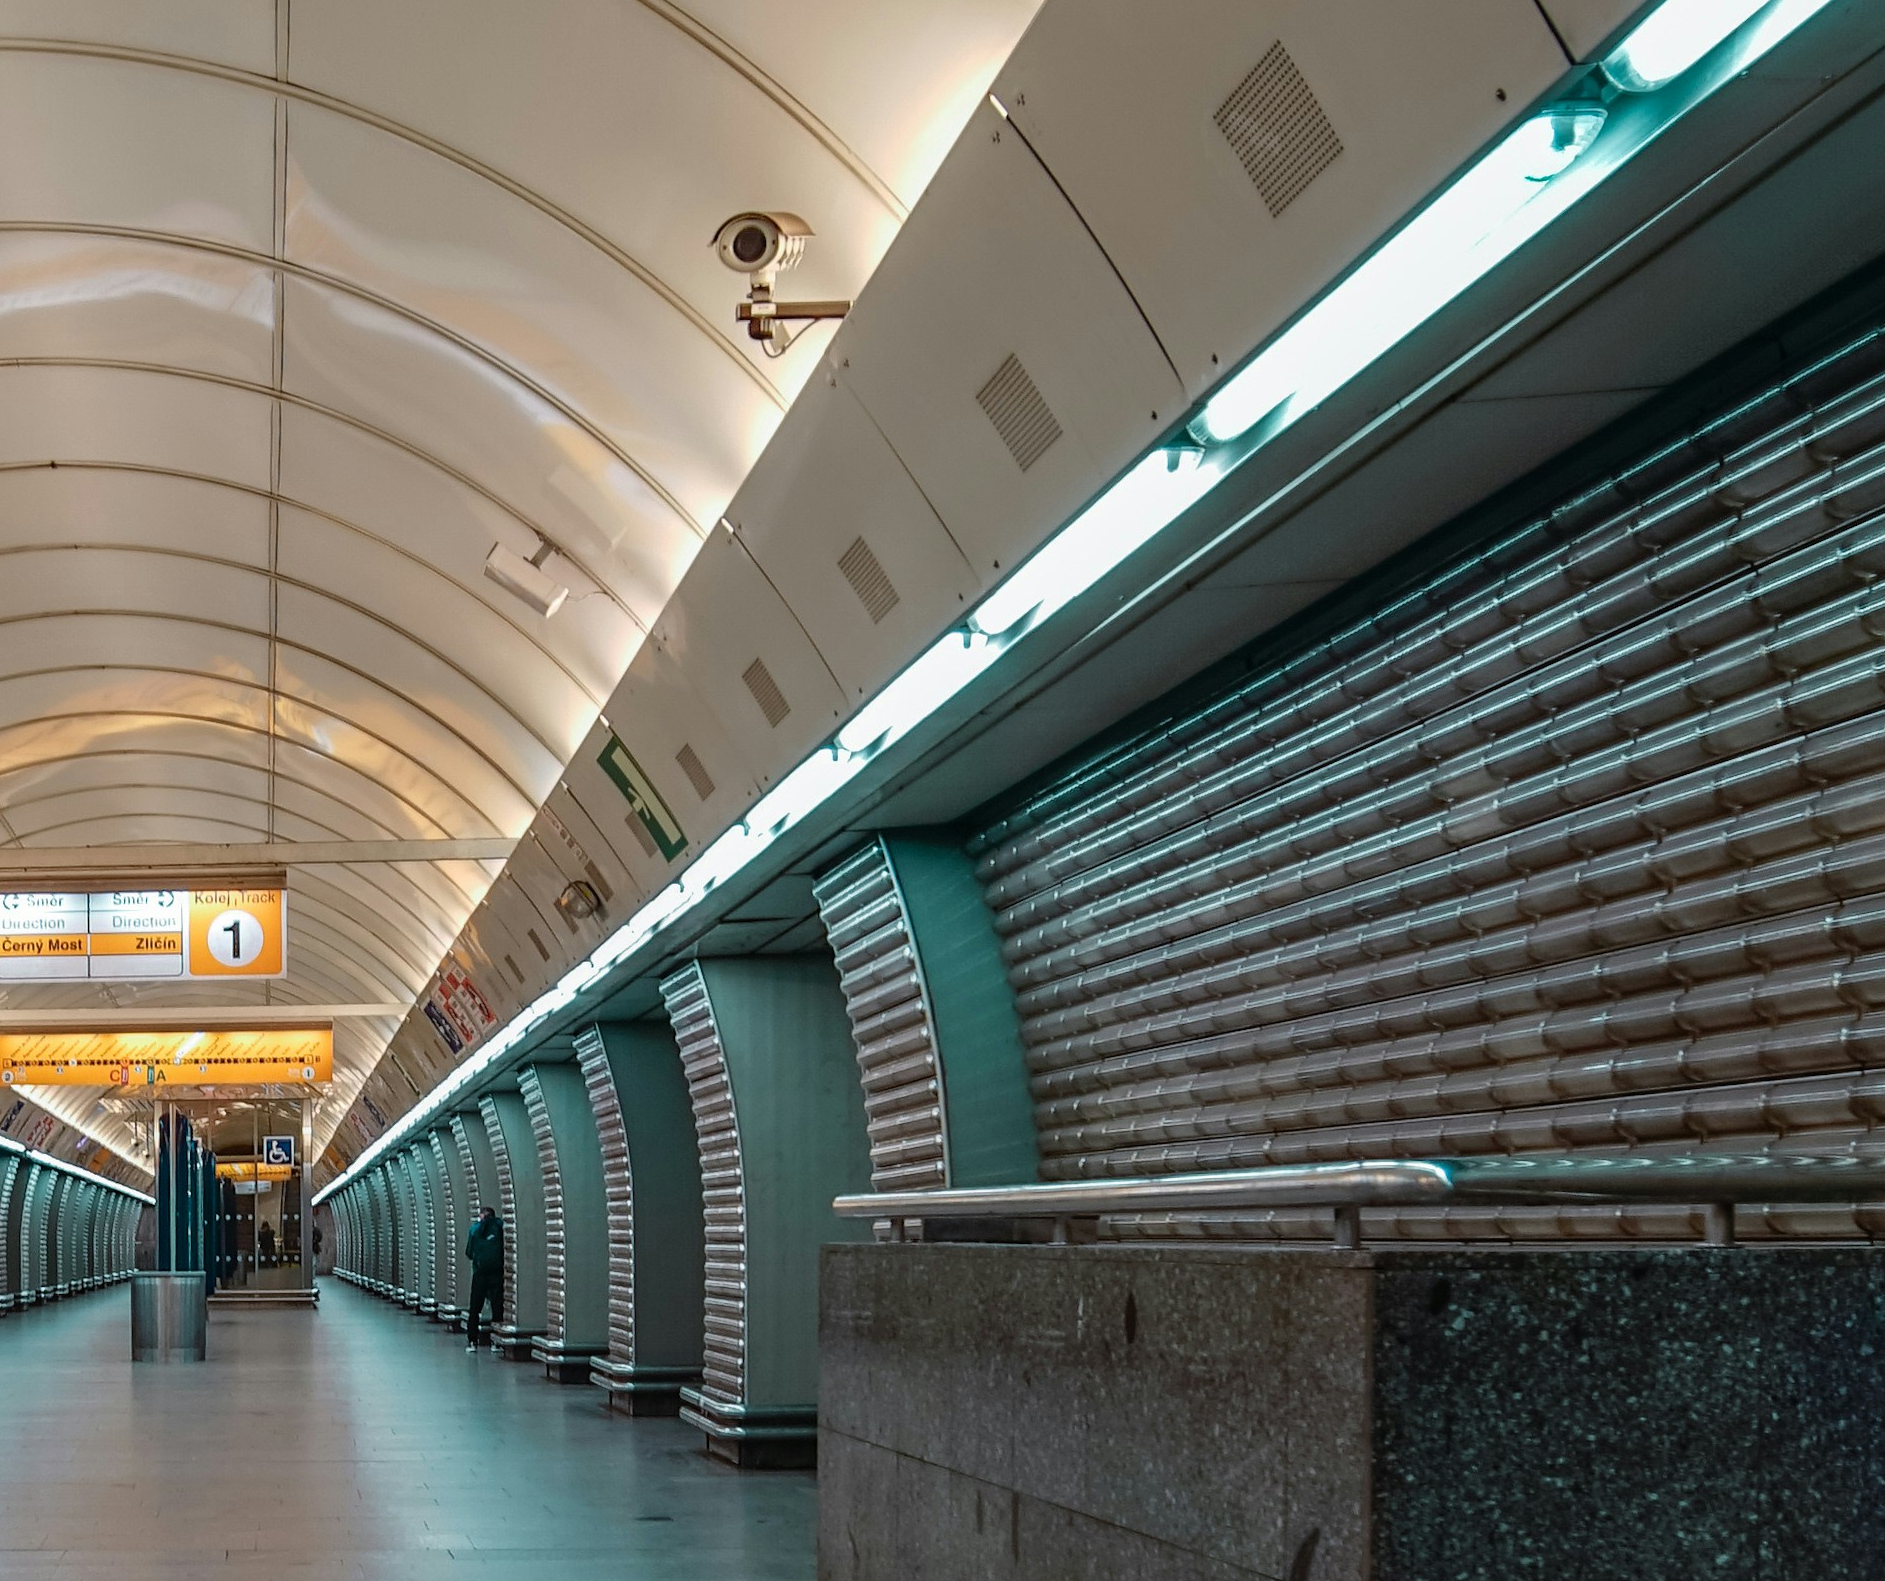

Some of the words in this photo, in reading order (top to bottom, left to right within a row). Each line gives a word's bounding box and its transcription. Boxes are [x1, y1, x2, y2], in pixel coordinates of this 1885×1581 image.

[195, 891, 230, 906] Kolej
[240, 890, 275, 904] Track
[2, 918, 65, 929] Direction
[113, 916, 176, 928] Direction
[2, 937, 43, 954] Černý
[48, 938, 82, 952] Most
[136, 937, 176, 950] Zličín
[223, 920, 241, 959] 1
[110, 1069, 120, 1082] C
[157, 1069, 166, 1082] A
